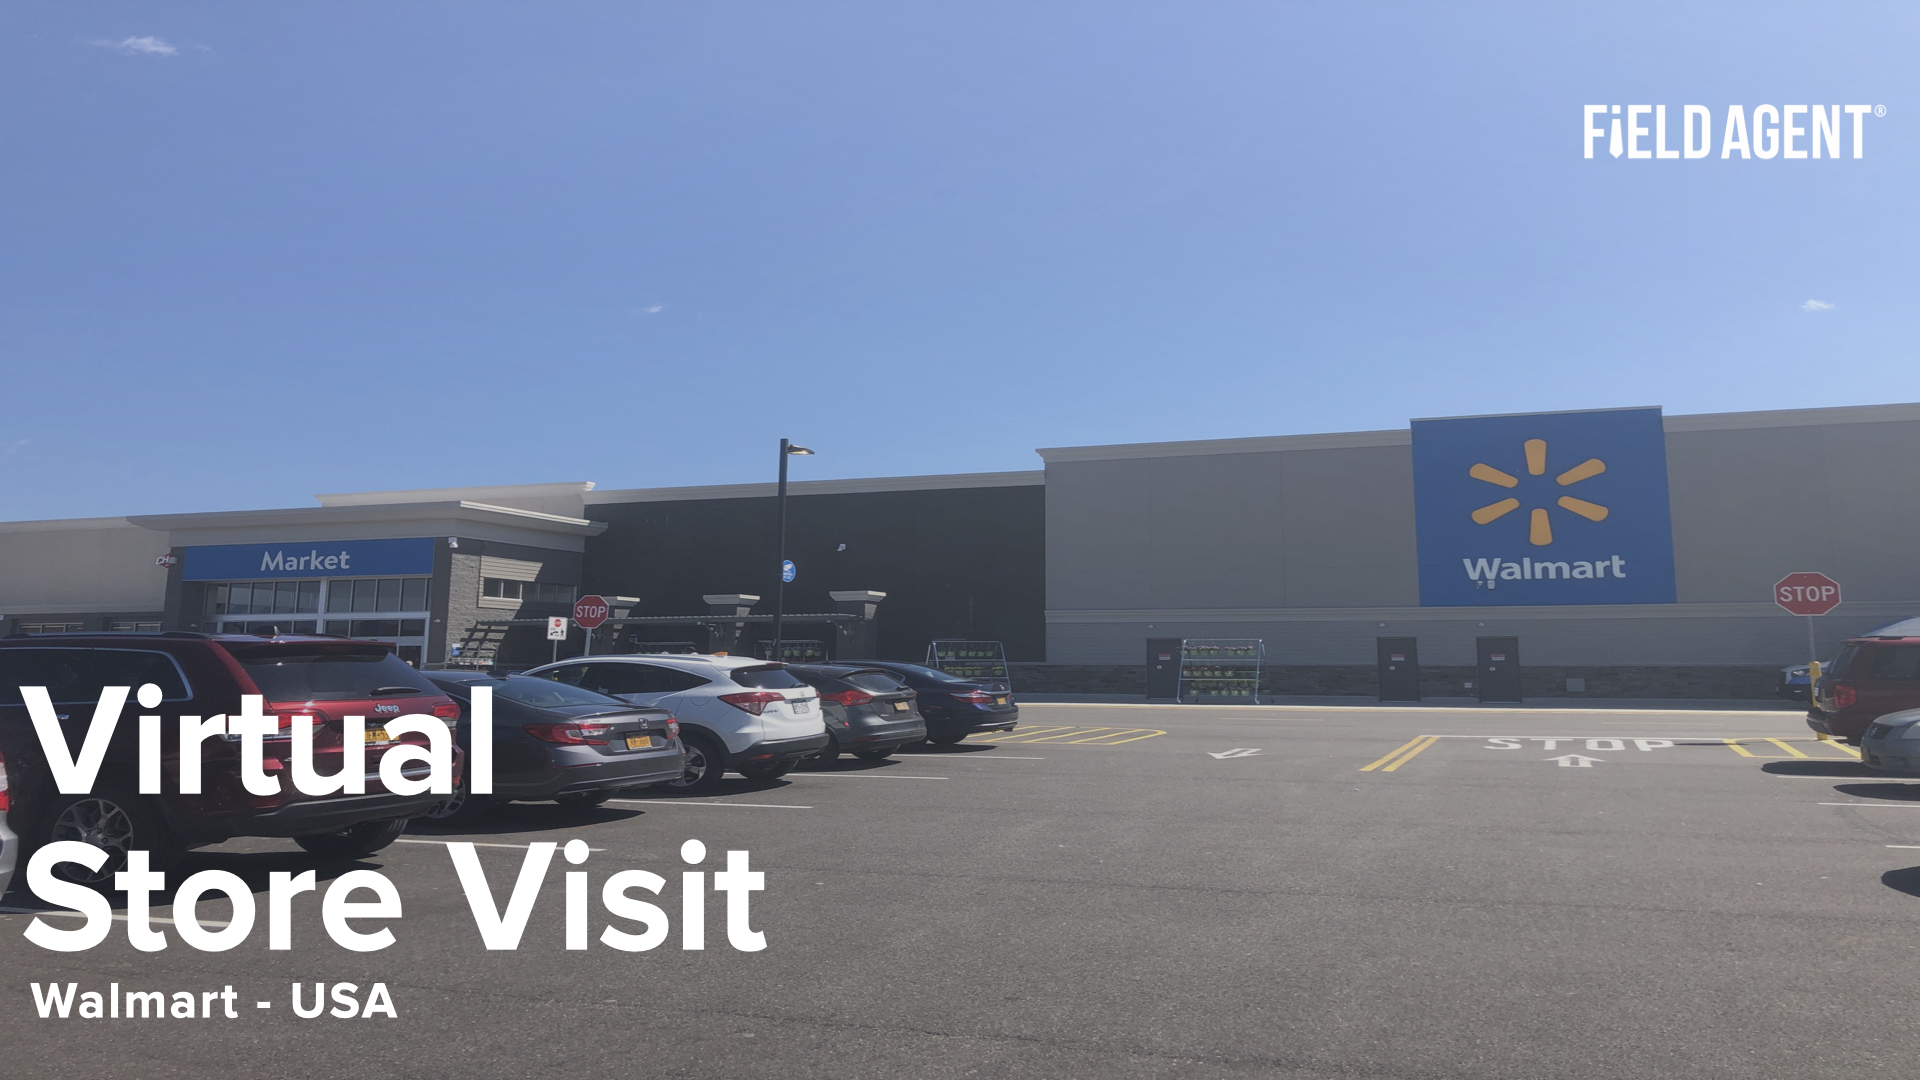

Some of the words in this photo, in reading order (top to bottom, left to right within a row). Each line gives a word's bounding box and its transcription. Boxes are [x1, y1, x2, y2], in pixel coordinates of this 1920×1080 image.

[260, 549, 351, 571] Market
[1462, 555, 1627, 581] Walmart
[1779, 585, 1836, 602] STOP
[575, 605, 606, 618] STOP
[374, 703, 400, 712] Jeep
[1483, 737, 1675, 752] STOP
